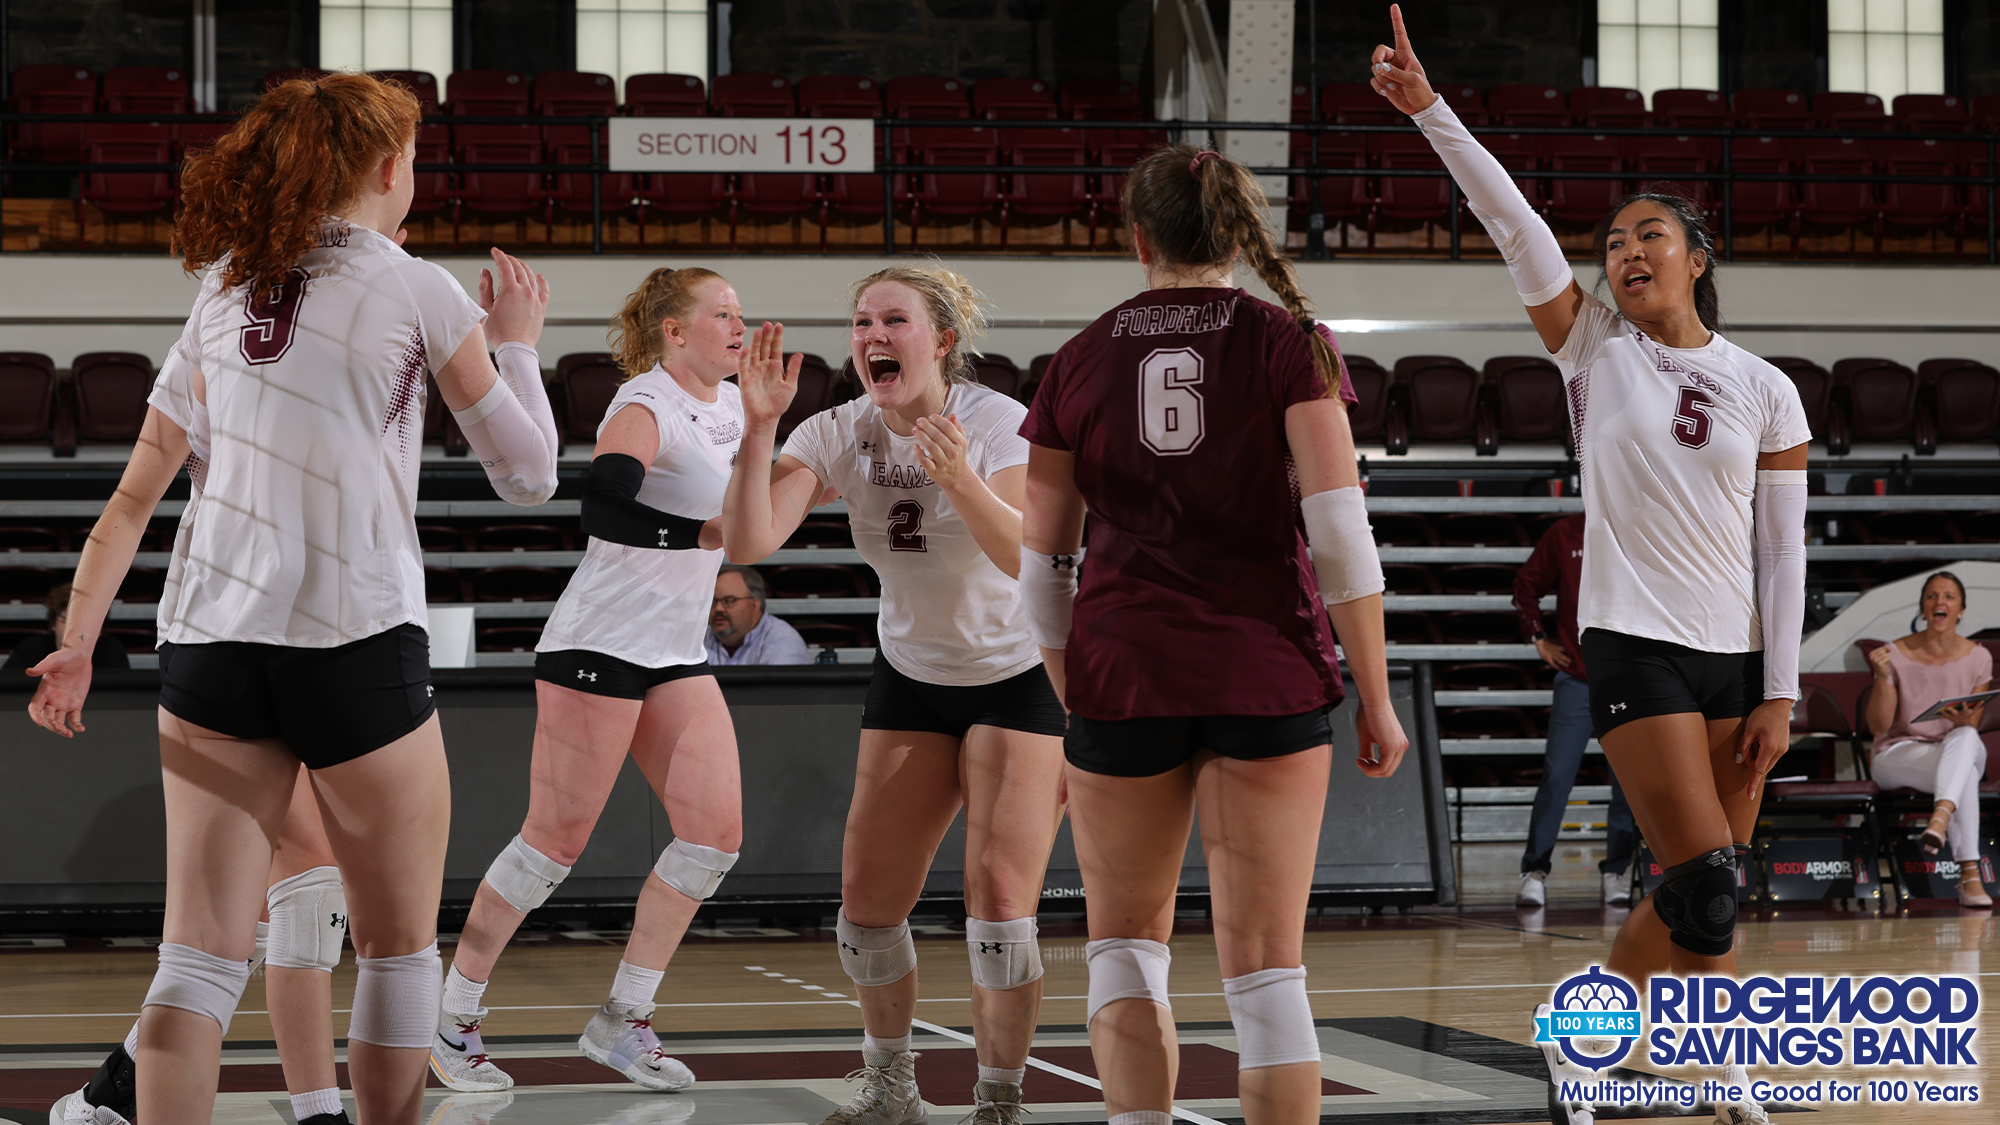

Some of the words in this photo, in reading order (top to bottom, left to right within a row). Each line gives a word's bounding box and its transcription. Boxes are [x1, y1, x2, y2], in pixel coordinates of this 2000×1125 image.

[638, 133, 757, 155] SECTION
[776, 125, 847, 165] 113
[239, 265, 311, 367] 9
[1112, 296, 1239, 337] FORDHAM
[1138, 346, 1206, 457] 6
[1670, 385, 1715, 450] 5
[887, 499, 928, 552] 2
[1773, 861, 1852, 875] BODYARMOR
